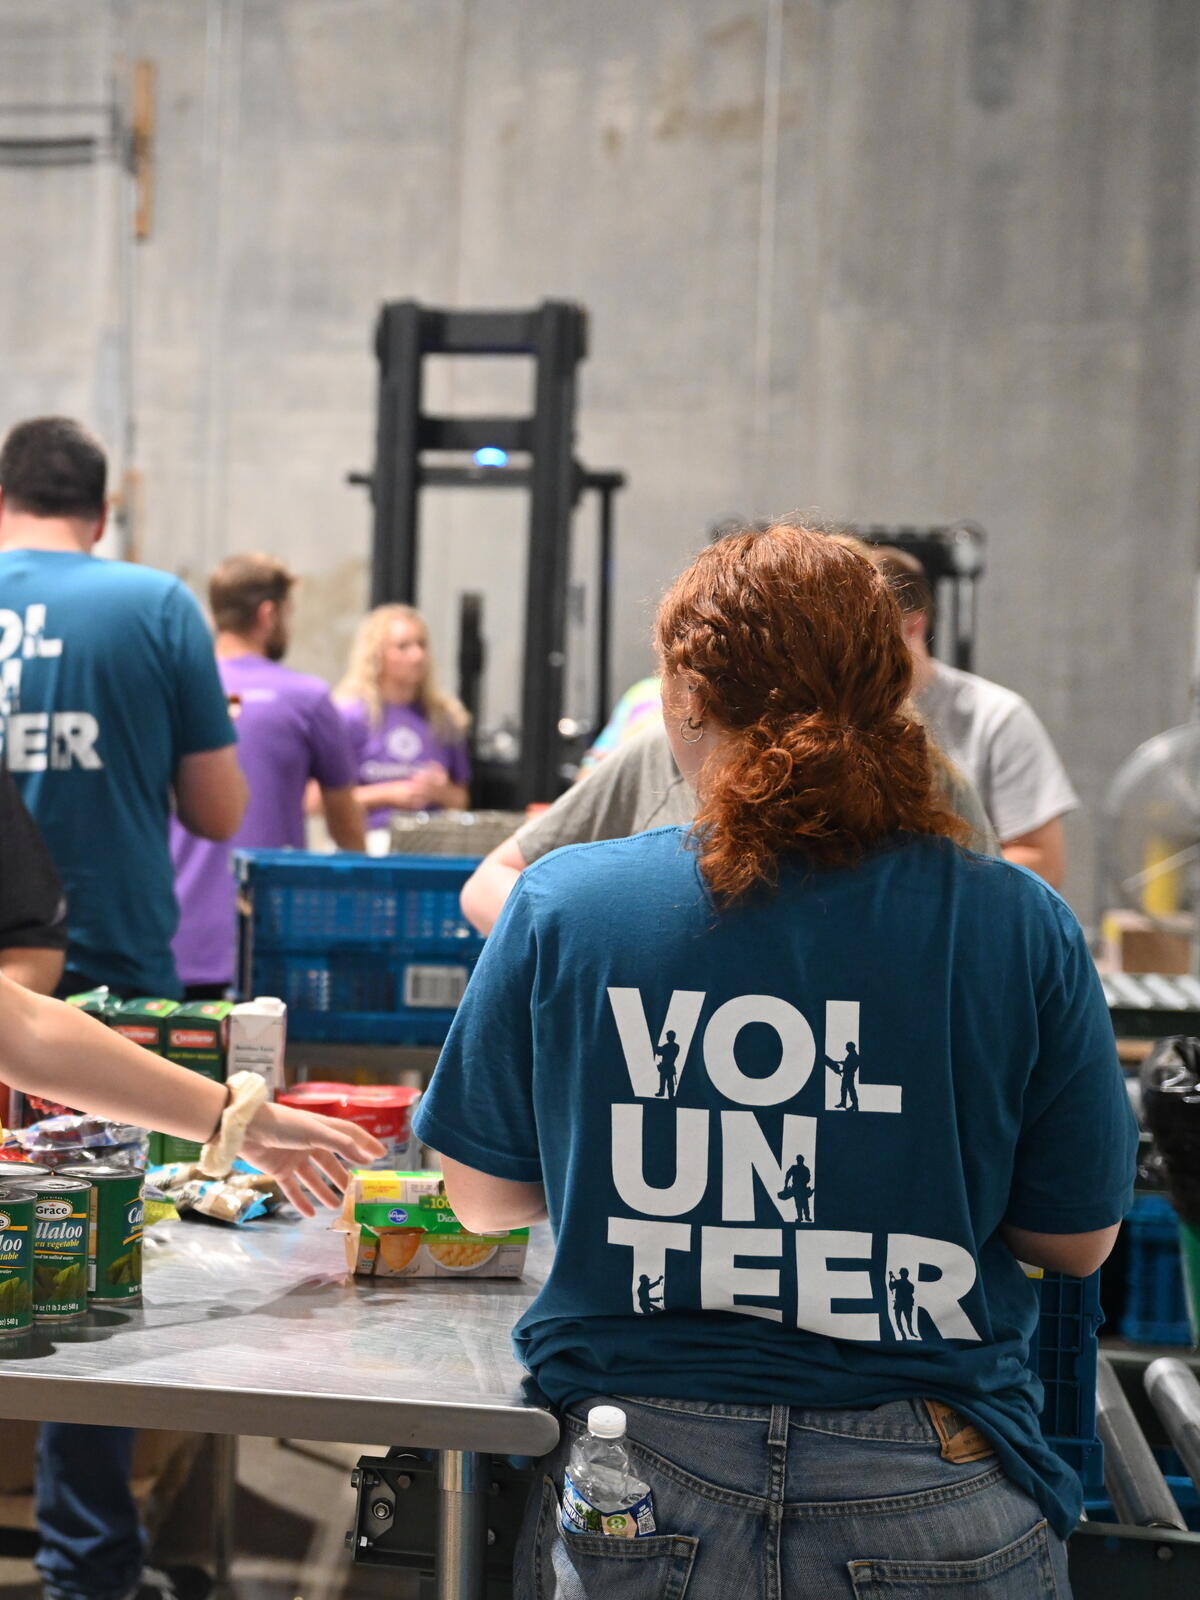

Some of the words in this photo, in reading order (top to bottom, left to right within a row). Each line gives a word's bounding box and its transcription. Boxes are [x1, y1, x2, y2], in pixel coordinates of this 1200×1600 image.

[607, 986, 902, 1114] VOL
[611, 1103, 818, 1223] UN
[36, 1206, 67, 1215] Grace
[35, 1222, 83, 1239] llaloo
[47, 1239, 80, 1250] vegetable
[607, 1216, 982, 1342] TEER
[6, 1317, 15, 1325] 540
